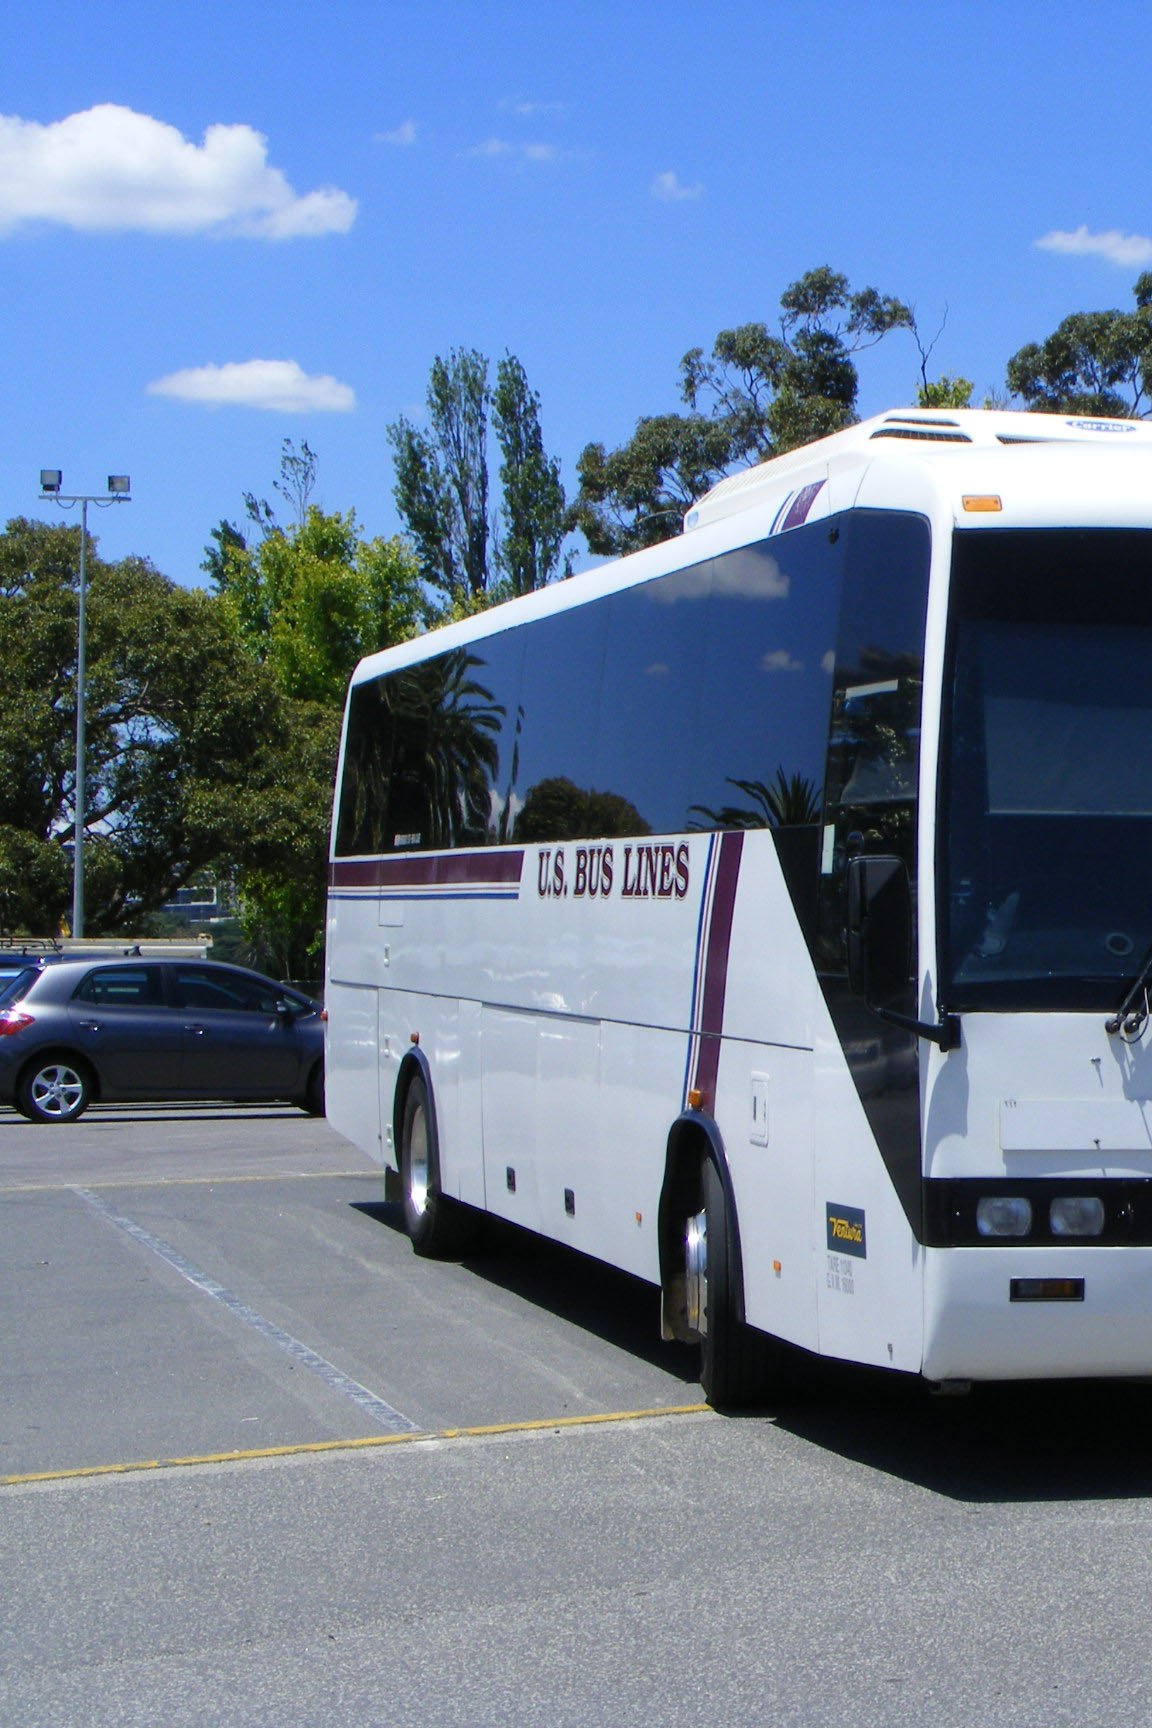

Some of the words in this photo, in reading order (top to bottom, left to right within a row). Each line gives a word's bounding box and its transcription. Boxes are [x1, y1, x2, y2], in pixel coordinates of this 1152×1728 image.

[538, 847, 568, 898] U.S.
[573, 843, 614, 899] BUS
[621, 840, 690, 901] LINES
